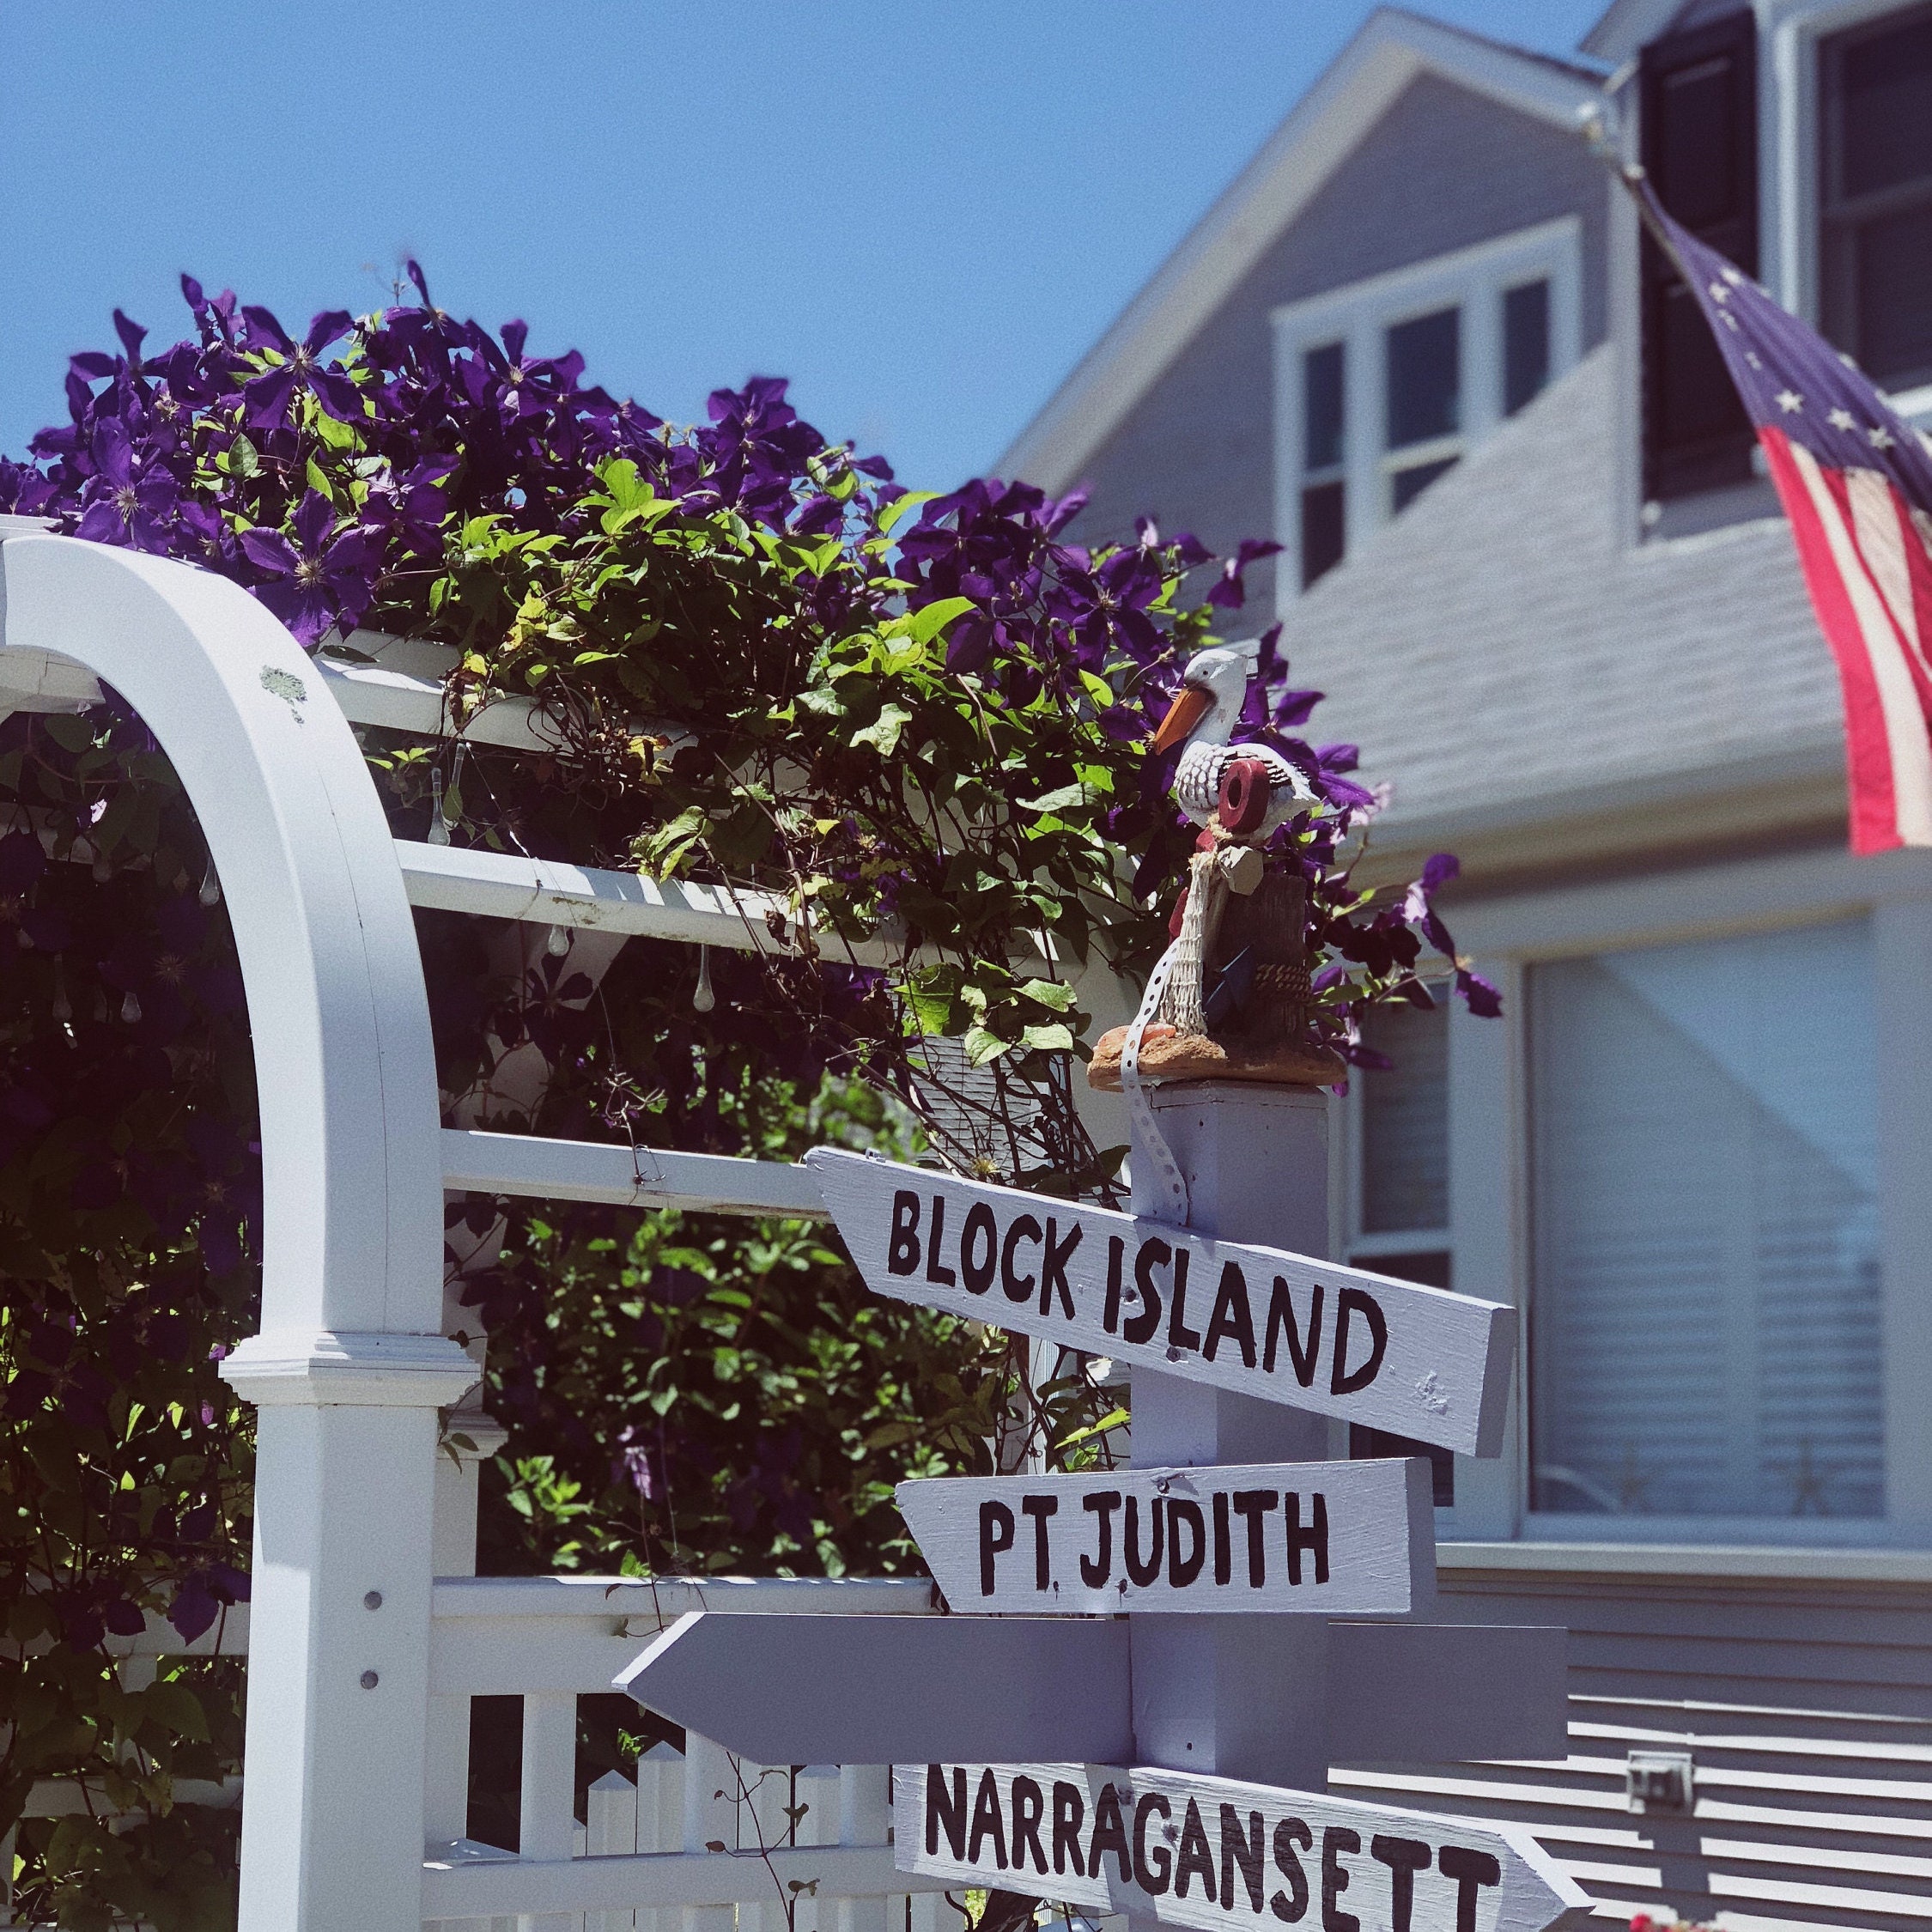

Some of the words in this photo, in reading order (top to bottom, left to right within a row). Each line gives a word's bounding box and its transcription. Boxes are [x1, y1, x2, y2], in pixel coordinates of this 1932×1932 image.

[887, 1190, 1083, 1320] BLOCK
[1103, 1235, 1388, 1396] ISLAND
[1079, 1489, 1329, 1590] JUDITH
[925, 1763, 1501, 1932] NARRAGANSETT
